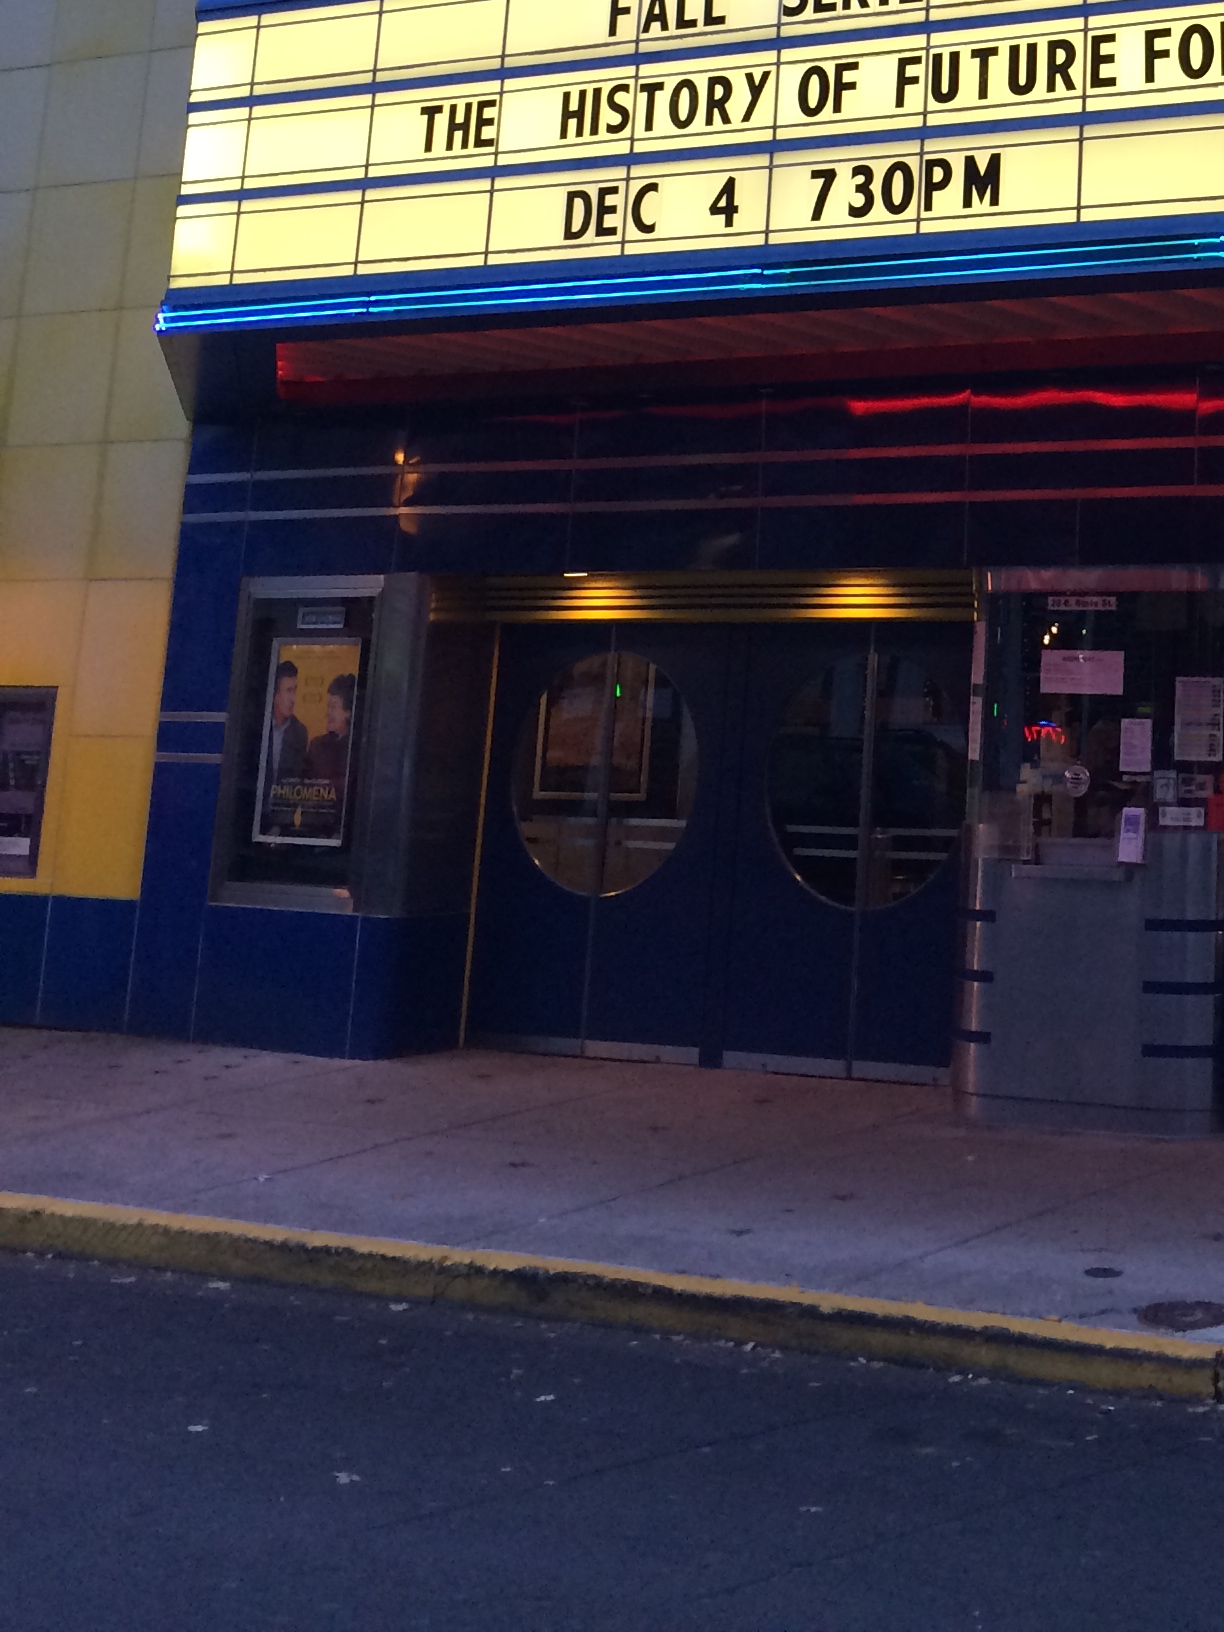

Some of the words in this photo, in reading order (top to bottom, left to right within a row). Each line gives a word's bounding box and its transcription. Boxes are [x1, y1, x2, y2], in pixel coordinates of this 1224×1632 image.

[420, 99, 498, 154] THE
[559, 69, 772, 141] HISTORY
[798, 62, 860, 118] OF
[895, 33, 1118, 109] FUTURE
[563, 181, 660, 242] DEC
[709, 175, 739, 229] 4
[810, 152, 1001, 222] 730PM
[270, 784, 337, 801] PHILOMENA
